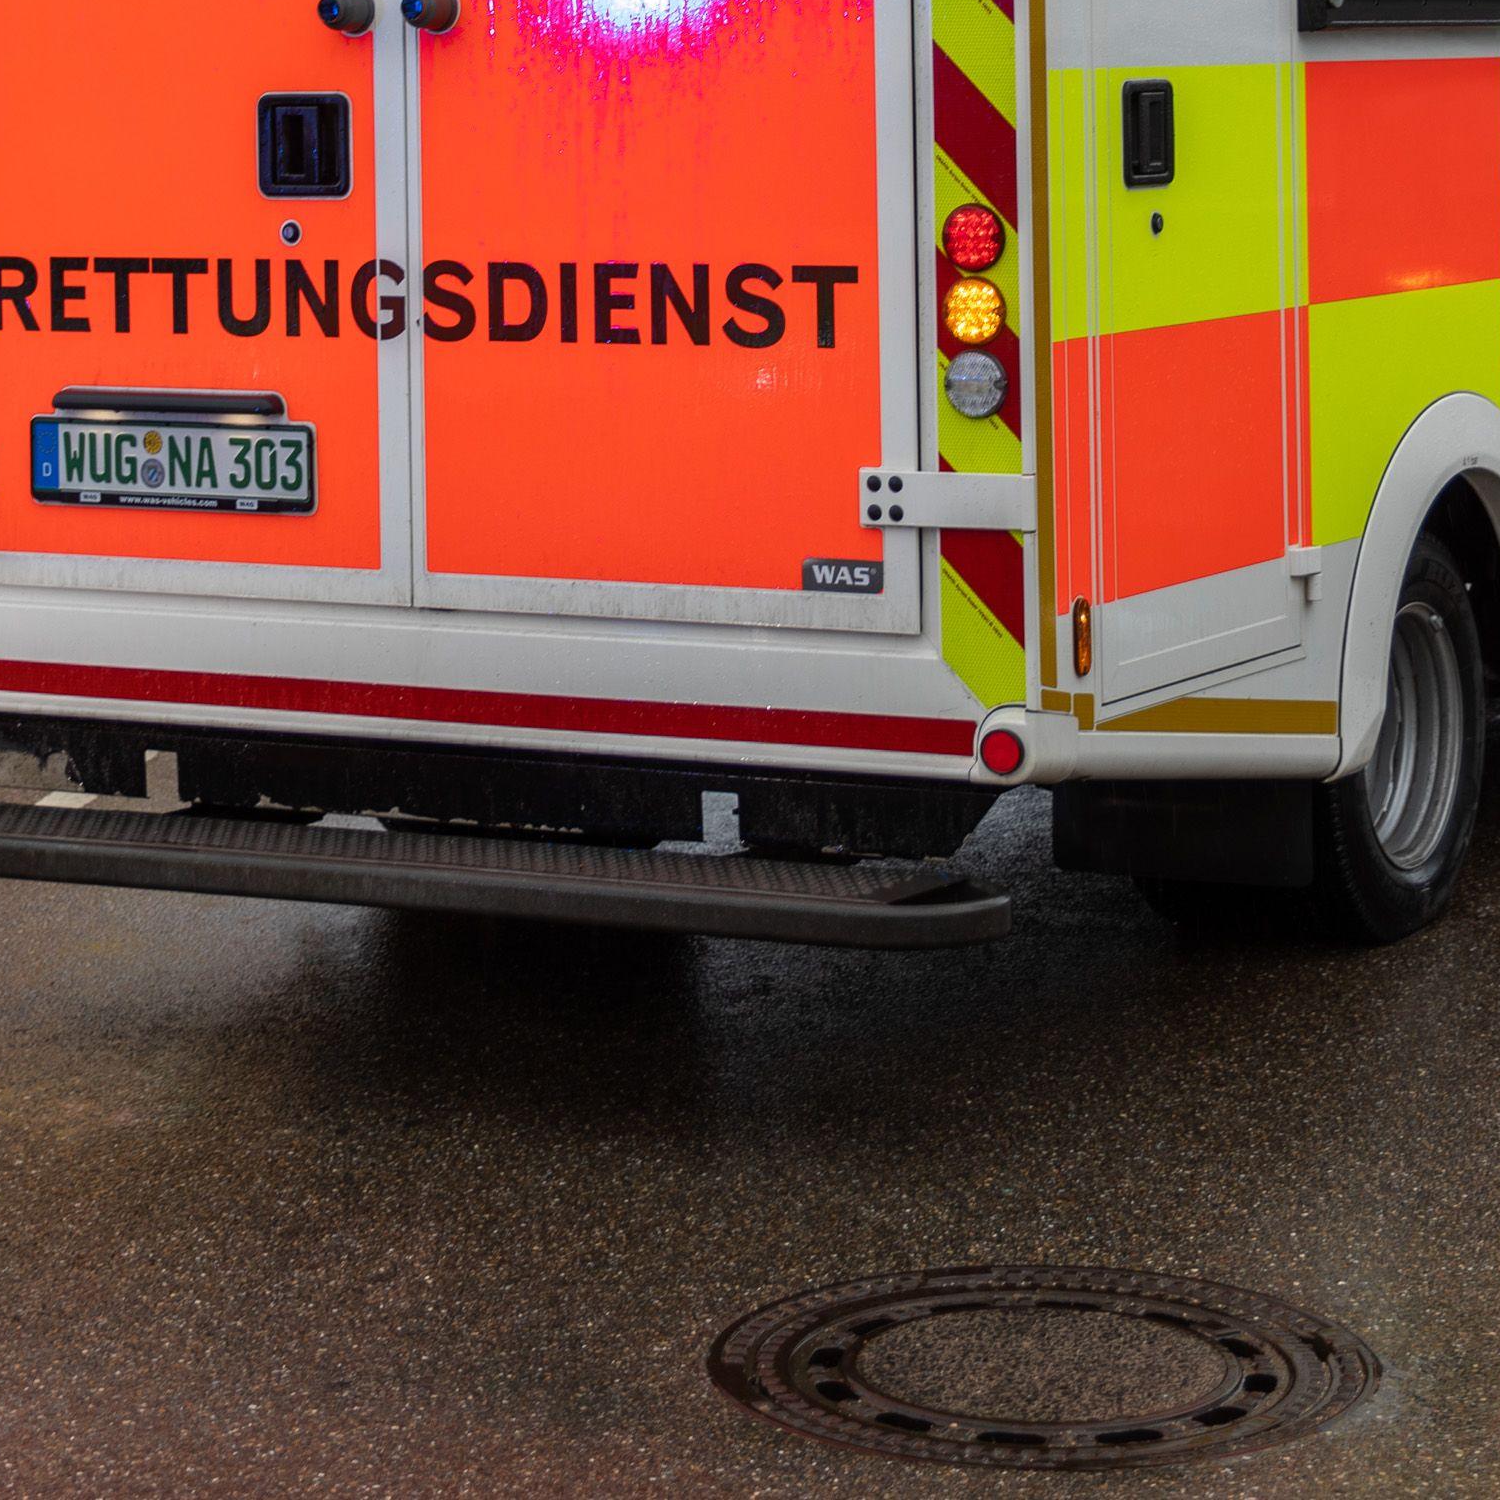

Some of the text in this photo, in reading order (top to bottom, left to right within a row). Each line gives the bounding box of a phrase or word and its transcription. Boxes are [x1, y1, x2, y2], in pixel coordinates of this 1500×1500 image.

[63, 431, 304, 492] WUG NA 303
[812, 564, 870, 586] WAS
